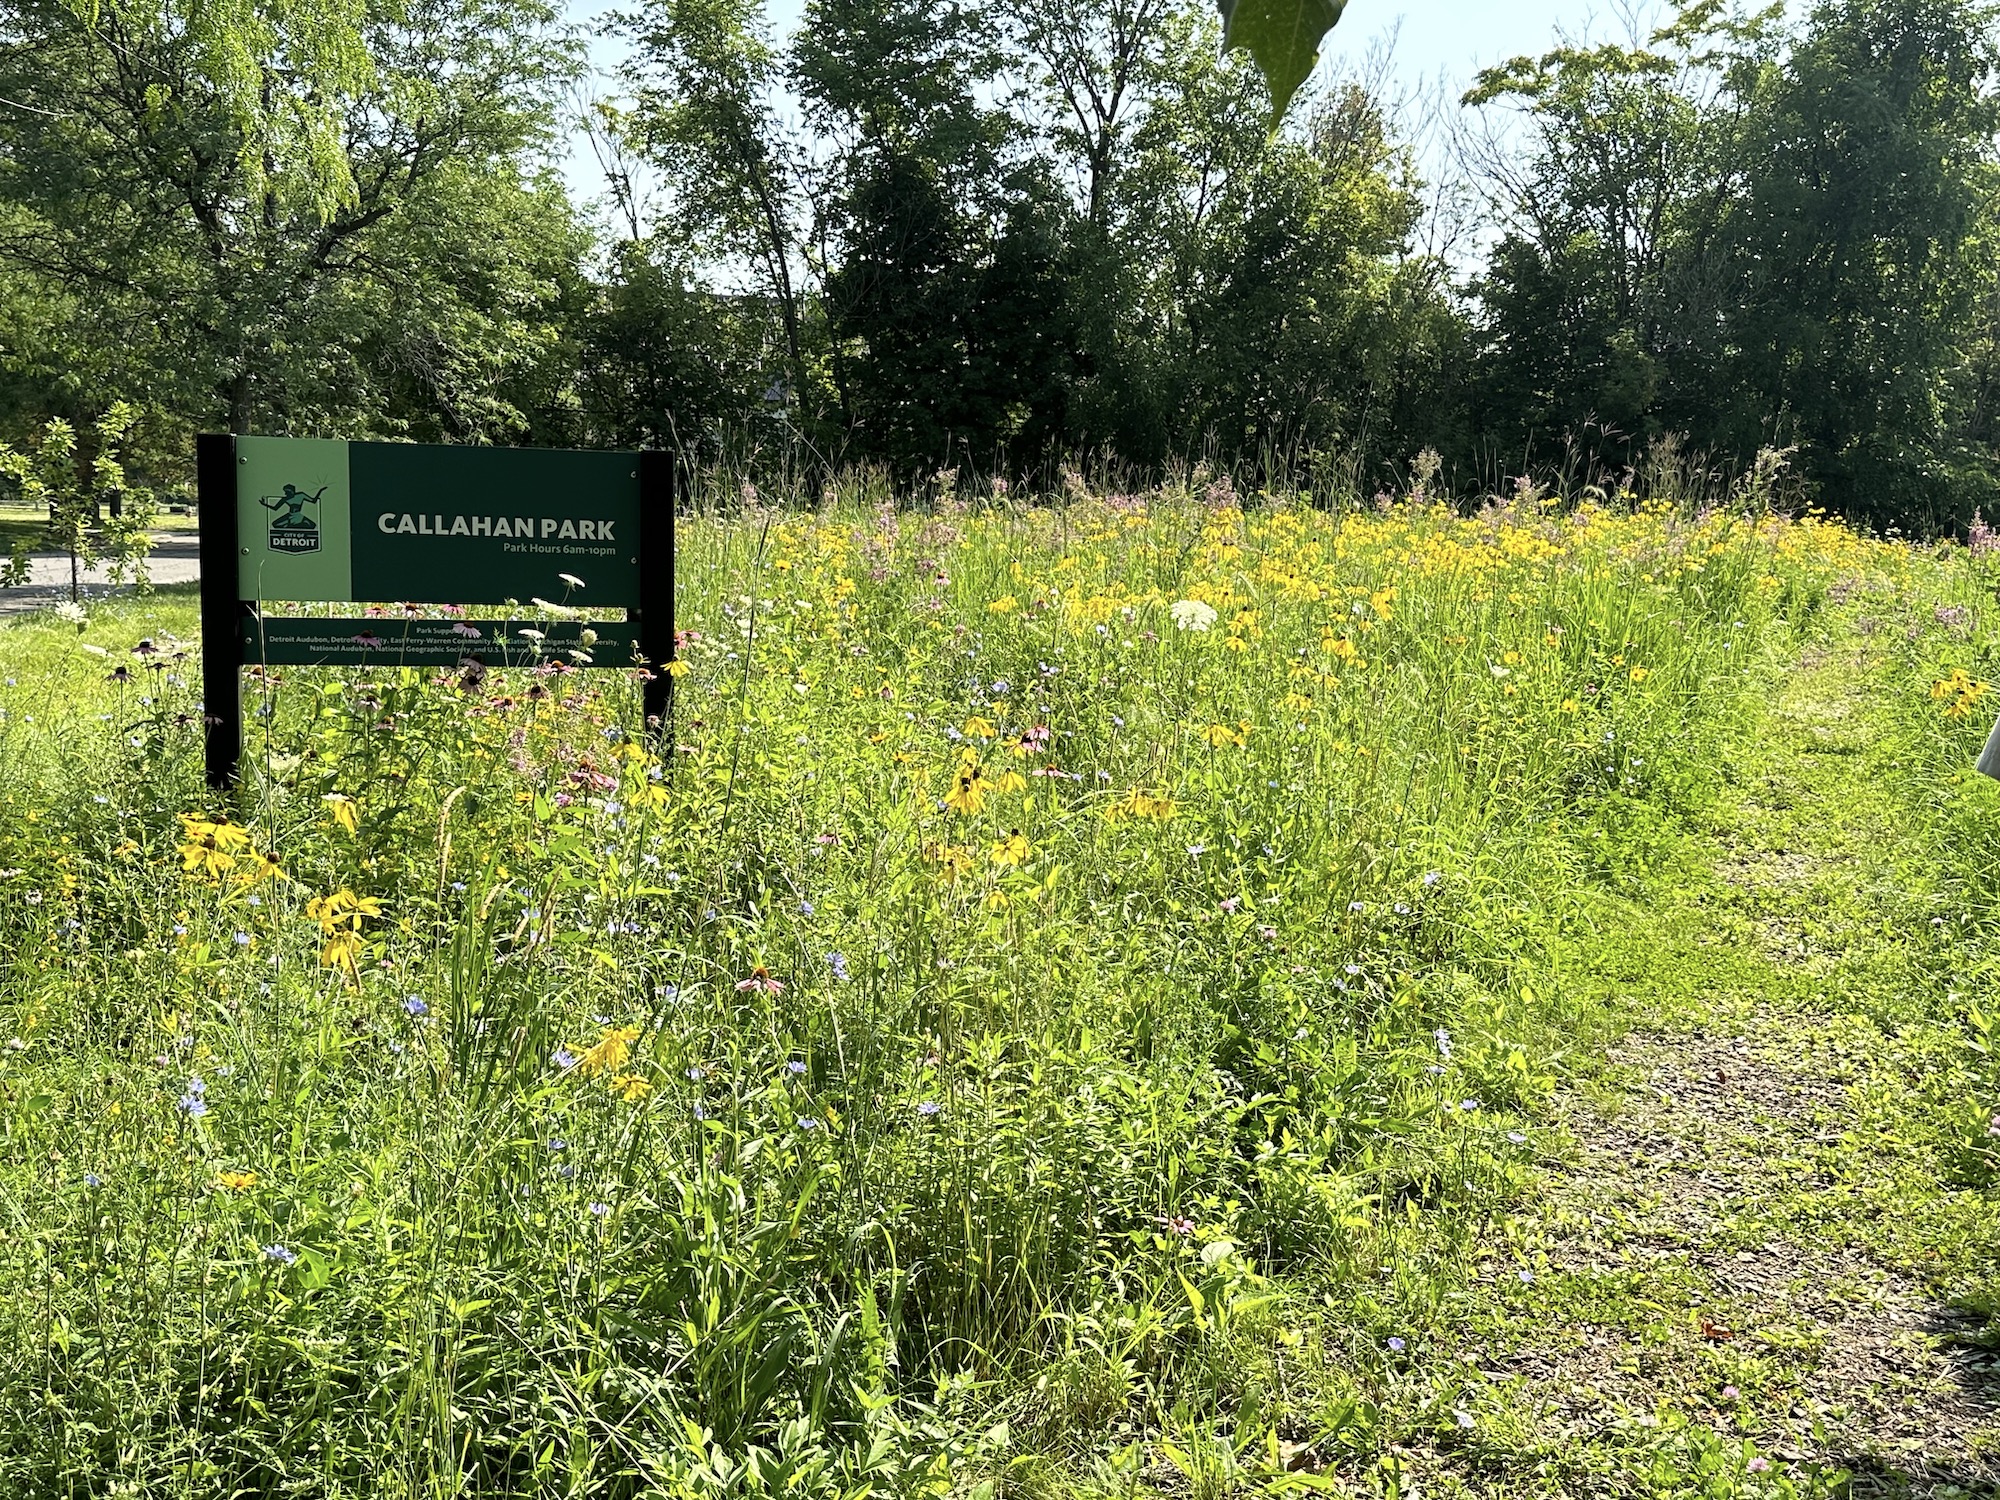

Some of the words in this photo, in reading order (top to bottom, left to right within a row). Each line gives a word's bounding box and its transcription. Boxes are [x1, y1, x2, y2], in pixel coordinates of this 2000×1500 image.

[378, 512, 534, 539] CALLAHAN
[541, 518, 615, 541] PARK
[272, 537, 316, 547] DETROIT
[503, 543, 527, 552] Park
[529, 544, 561, 554] Hours
[563, 545, 616, 557] 6am-10pm
[269, 635, 295, 643] Detroit
[405, 637, 451, 645] Ferry-Warren
[405, 646, 445, 655] Geographic
